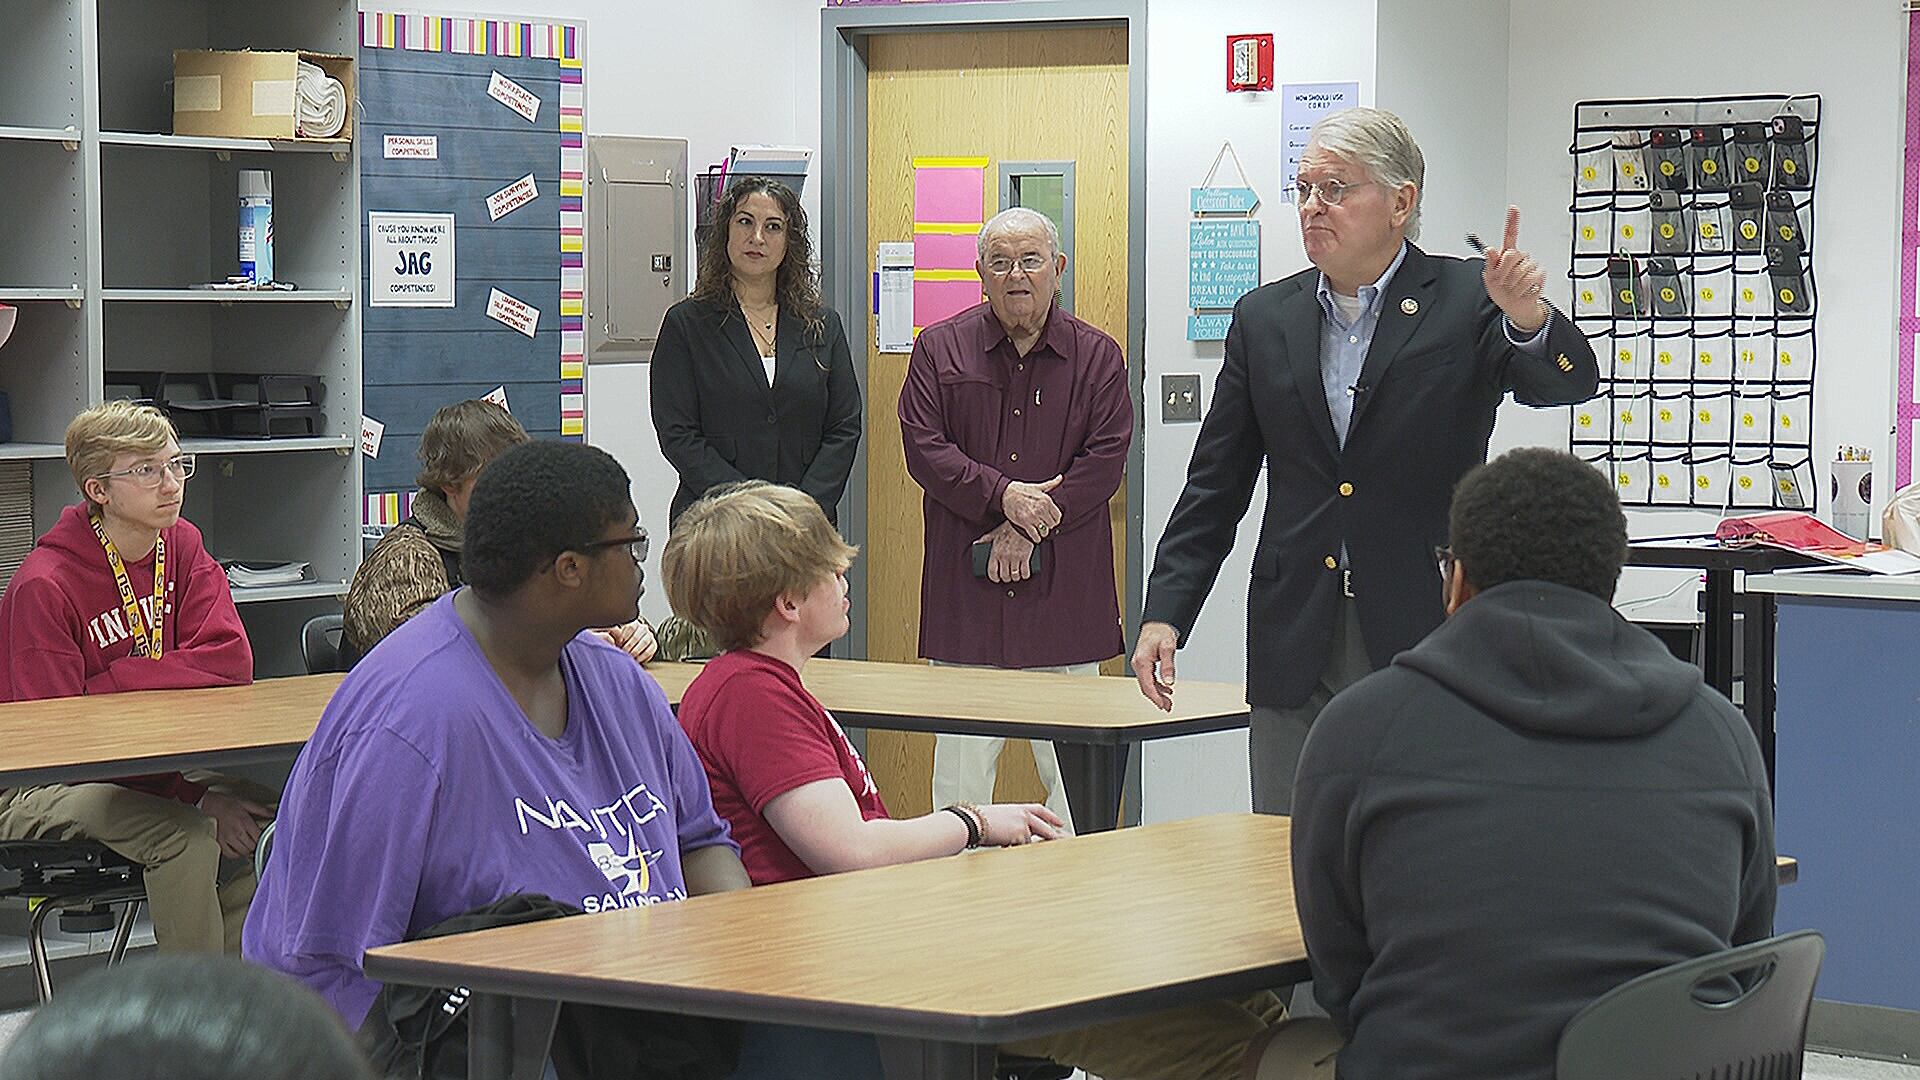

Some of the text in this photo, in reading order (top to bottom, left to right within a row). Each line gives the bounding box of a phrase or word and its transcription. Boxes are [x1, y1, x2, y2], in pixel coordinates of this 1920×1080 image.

[388, 137, 415, 145] PERSONAL
[391, 148, 430, 156] COMPETENCIES
[378, 225, 396, 233] CAUSE
[397, 225, 410, 233] YOU
[411, 225, 428, 233] KNOW
[387, 236, 438, 244] ALL ABOUT THOSE
[395, 250, 432, 275] JAG
[1191, 285, 1235, 295] DREAM BIG
[1194, 318, 1229, 328] ALWAY
[1194, 328, 1221, 338] YOUR
[117, 573, 135, 607] LSU
